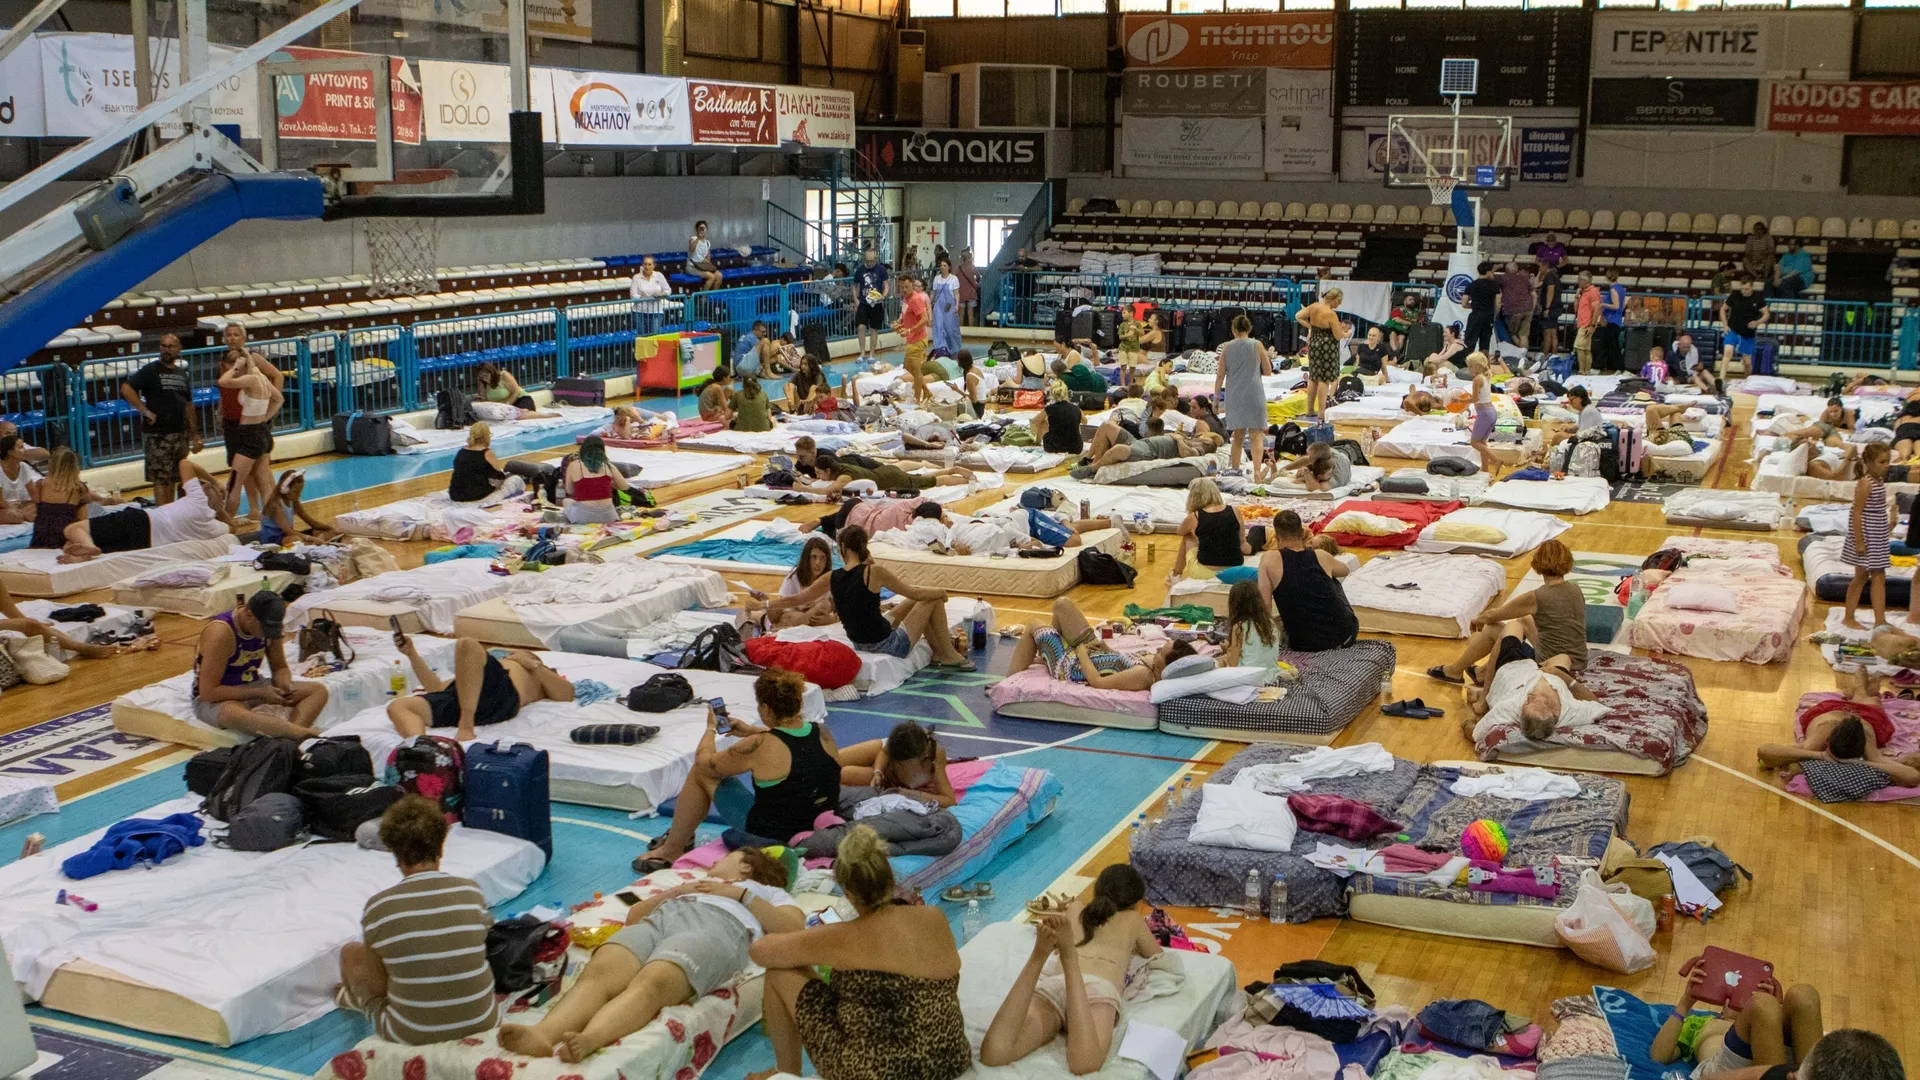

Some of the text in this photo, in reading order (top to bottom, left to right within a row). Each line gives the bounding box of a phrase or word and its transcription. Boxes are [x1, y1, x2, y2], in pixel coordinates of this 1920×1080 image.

[1395, 66, 1418, 74] HOME
[1500, 66, 1528, 74] GUEST
[1138, 74, 1253, 88] ROUBETI
[325, 93, 352, 107] PRINT
[354, 97, 361, 108] &
[693, 86, 757, 114] Bailando
[1385, 97, 1409, 106] FOULS
[1509, 98, 1533, 106] FOULS
[1775, 83, 1862, 108] RODOS
[440, 104, 490, 125] IDOLO
[1636, 104, 1715, 116] semiramis
[574, 111, 631, 130] ΜΙΧΑΗΛΟΥ
[1773, 112, 1839, 124] RENT A CAR
